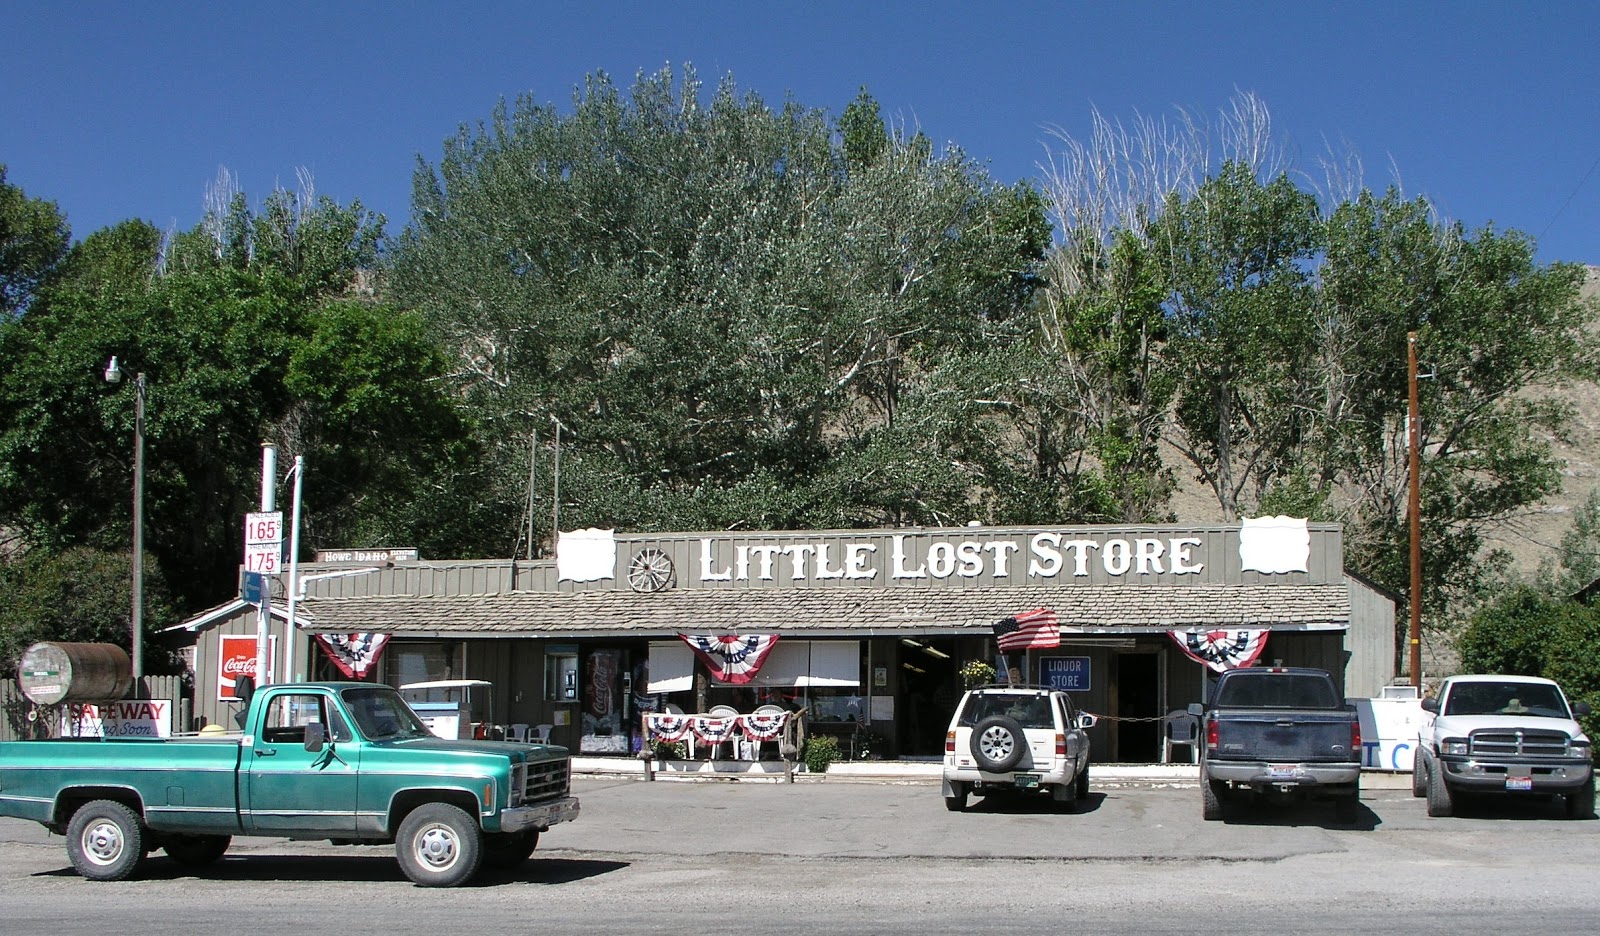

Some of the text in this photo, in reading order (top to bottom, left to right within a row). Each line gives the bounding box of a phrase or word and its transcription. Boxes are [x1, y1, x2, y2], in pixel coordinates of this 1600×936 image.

[324, 551, 352, 562] HOWE
[354, 551, 388, 562] IDAHO
[700, 533, 1205, 581] LITTLE LOST STORE
[1048, 660, 1082, 687] LIQUOR STORE
[71, 703, 165, 719] SAFEWAY
